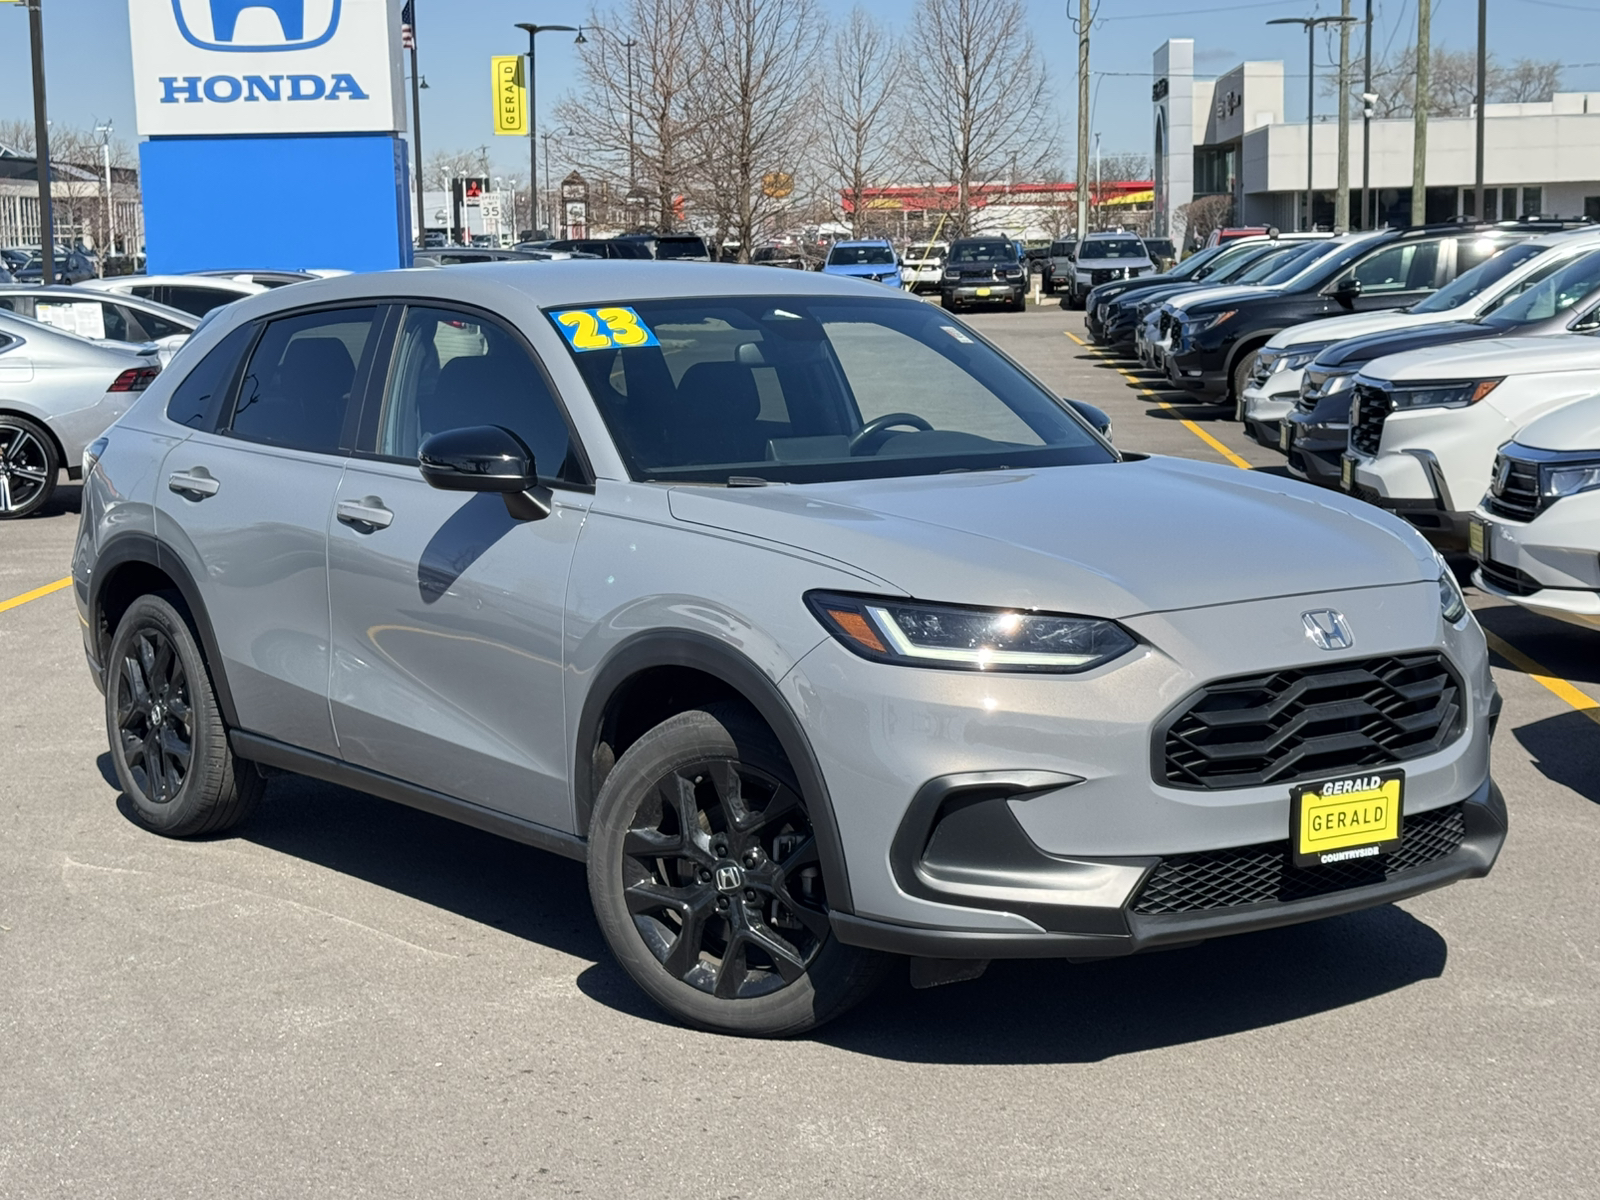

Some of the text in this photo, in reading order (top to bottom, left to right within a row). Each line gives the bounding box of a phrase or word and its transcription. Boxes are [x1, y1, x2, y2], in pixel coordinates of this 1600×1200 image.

[159, 73, 370, 104] HONDA
[504, 66, 515, 124] GERALD
[482, 206, 500, 217] 35
[558, 307, 649, 349] 23
[1322, 776, 1381, 797] GERALD
[1312, 806, 1383, 832] GERALD
[1321, 846, 1380, 864] COUNTRYSIDE
